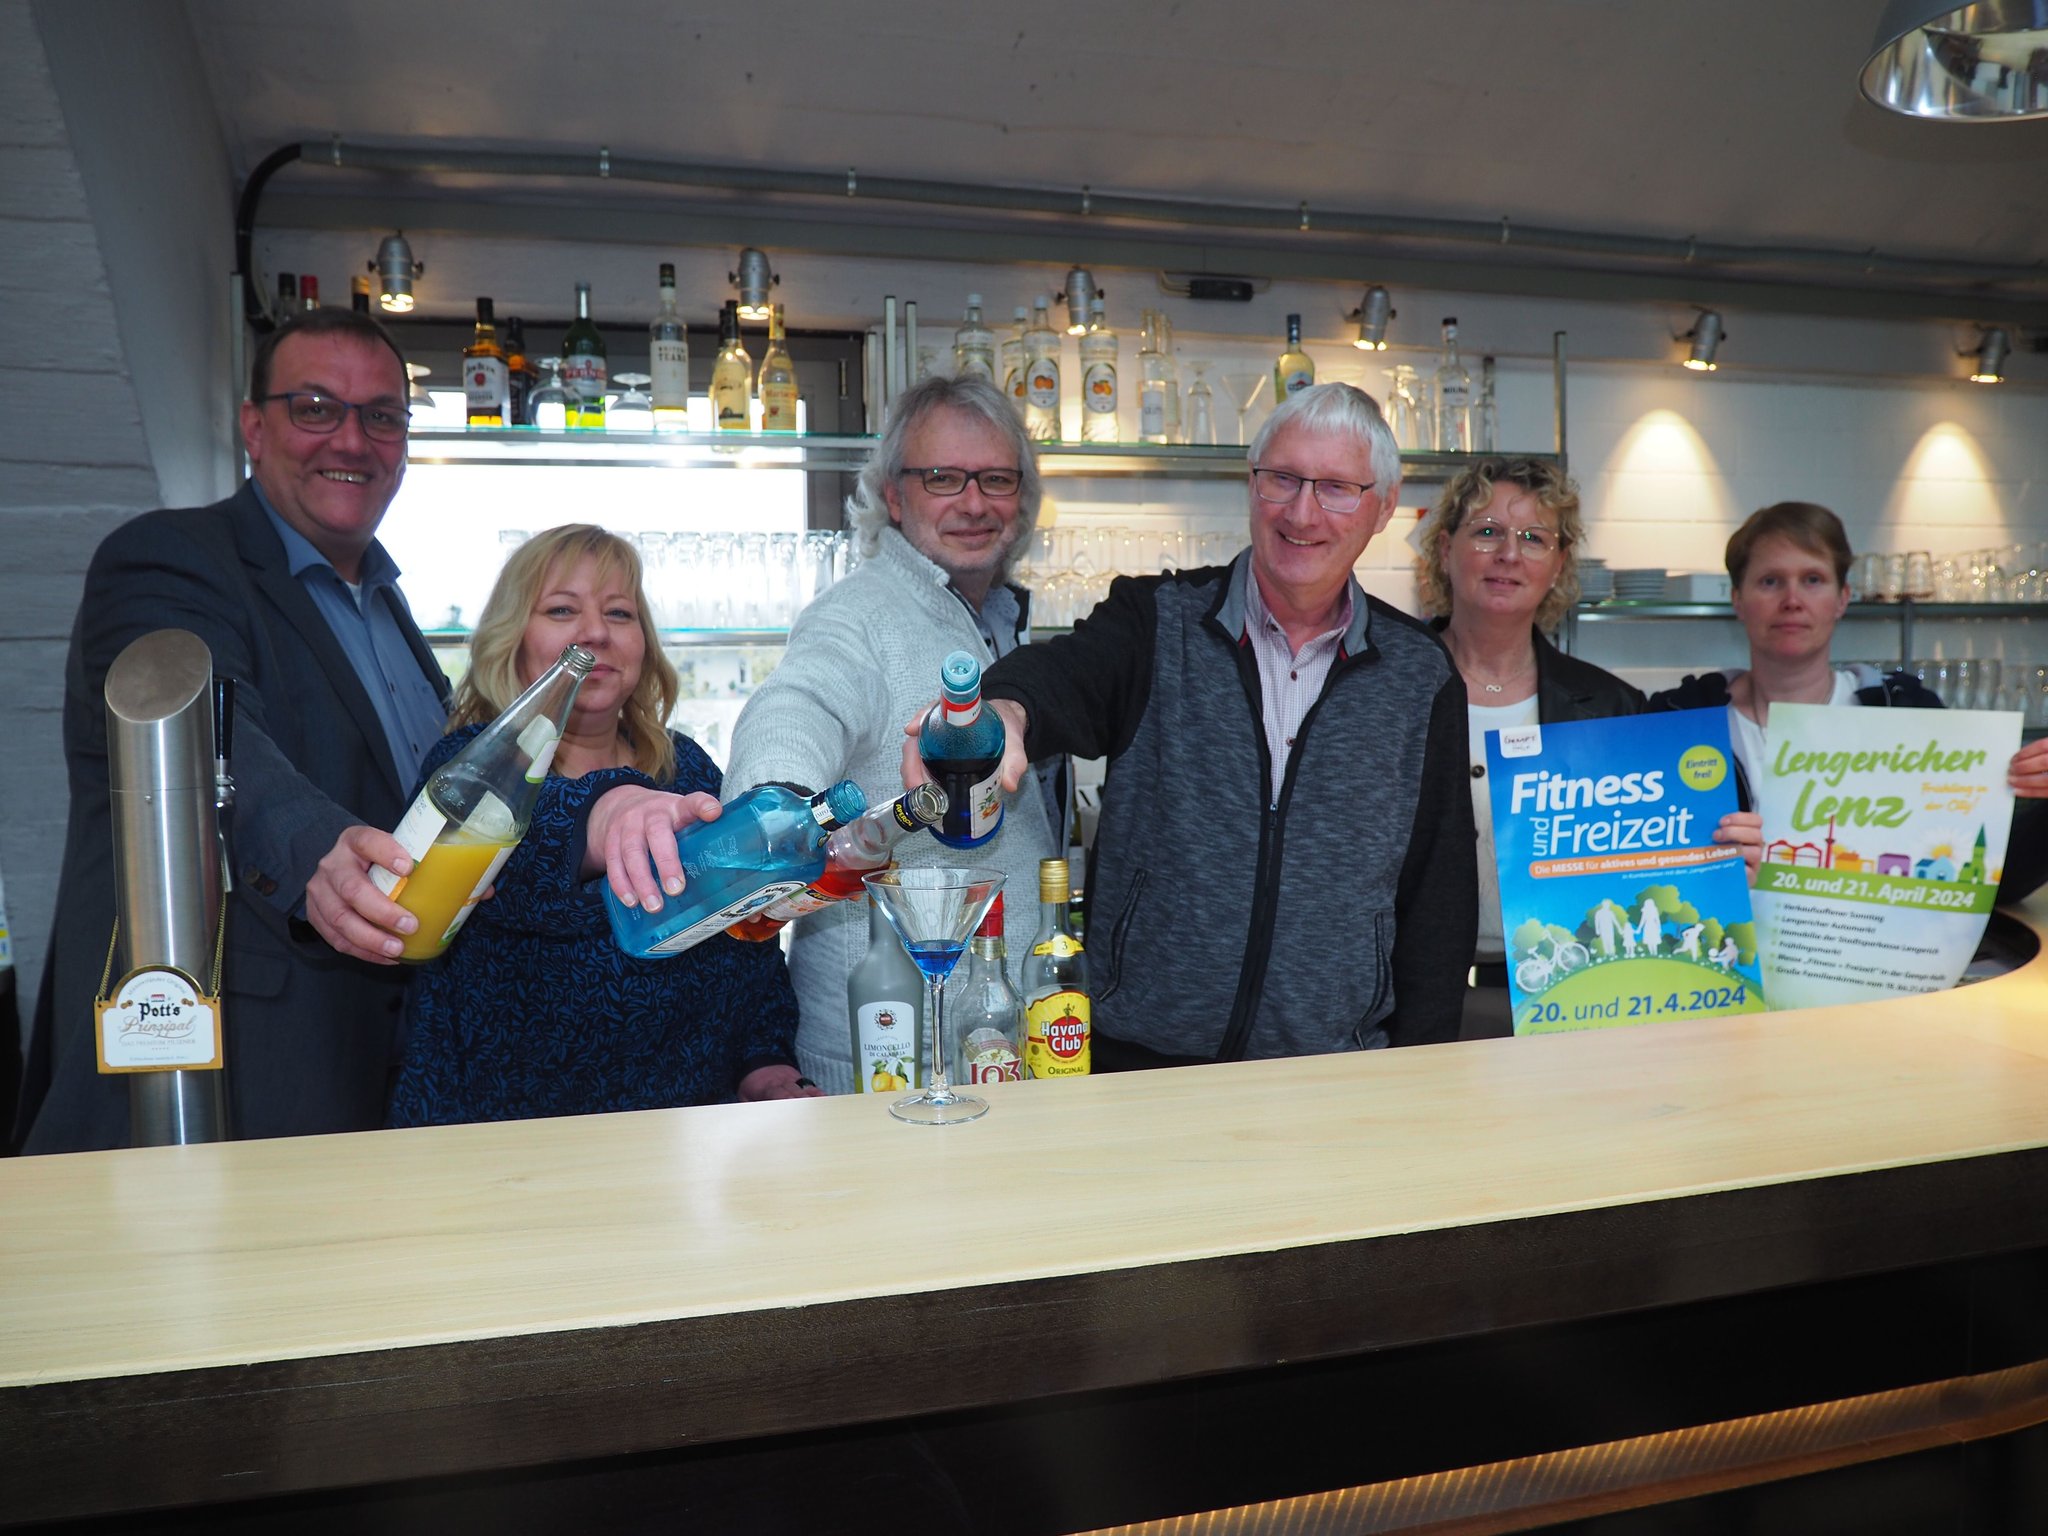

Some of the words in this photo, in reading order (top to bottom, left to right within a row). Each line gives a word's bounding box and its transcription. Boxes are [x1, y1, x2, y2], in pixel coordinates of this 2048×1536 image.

[1685, 758, 1718, 769] Eintritt
[1773, 739, 1987, 787] Lengericher
[1511, 770, 1664, 814] Fitness
[895, 803, 914, 827] APEROL
[1791, 779, 1912, 832] Lenz
[1529, 817, 1549, 857] und
[1550, 805, 1694, 855] Freizeit
[1534, 864, 1550, 874] Die
[1551, 863, 1584, 874] MESSE
[1585, 860, 1599, 871] für
[1600, 858, 1635, 870] aktives
[1636, 856, 1656, 866] und
[1658, 853, 1705, 866] gesundes
[1707, 848, 1737, 860] Leben
[1772, 871, 1801, 889] 20.
[1804, 877, 1842, 894] und
[1844, 880, 1874, 897] 21.
[1877, 885, 1926, 905] April
[1926, 889, 1976, 909] 2024
[1782, 916, 1829, 928] Lengericher
[1831, 923, 1876, 934] Automarkt
[1850, 911, 1885, 923] Sonntag
[1061, 940, 1068, 950] 3
[138, 1002, 182, 1022] Pott's
[1530, 1002, 1567, 1023] 20.
[1575, 996, 1619, 1020] und
[1628, 984, 1747, 1016] 21.4.2024
[1041, 1021, 1089, 1036] Havana
[864, 1041, 911, 1052] LIMONCELLO
[1051, 1037, 1082, 1052] Club
[969, 1058, 1022, 1085] 103
